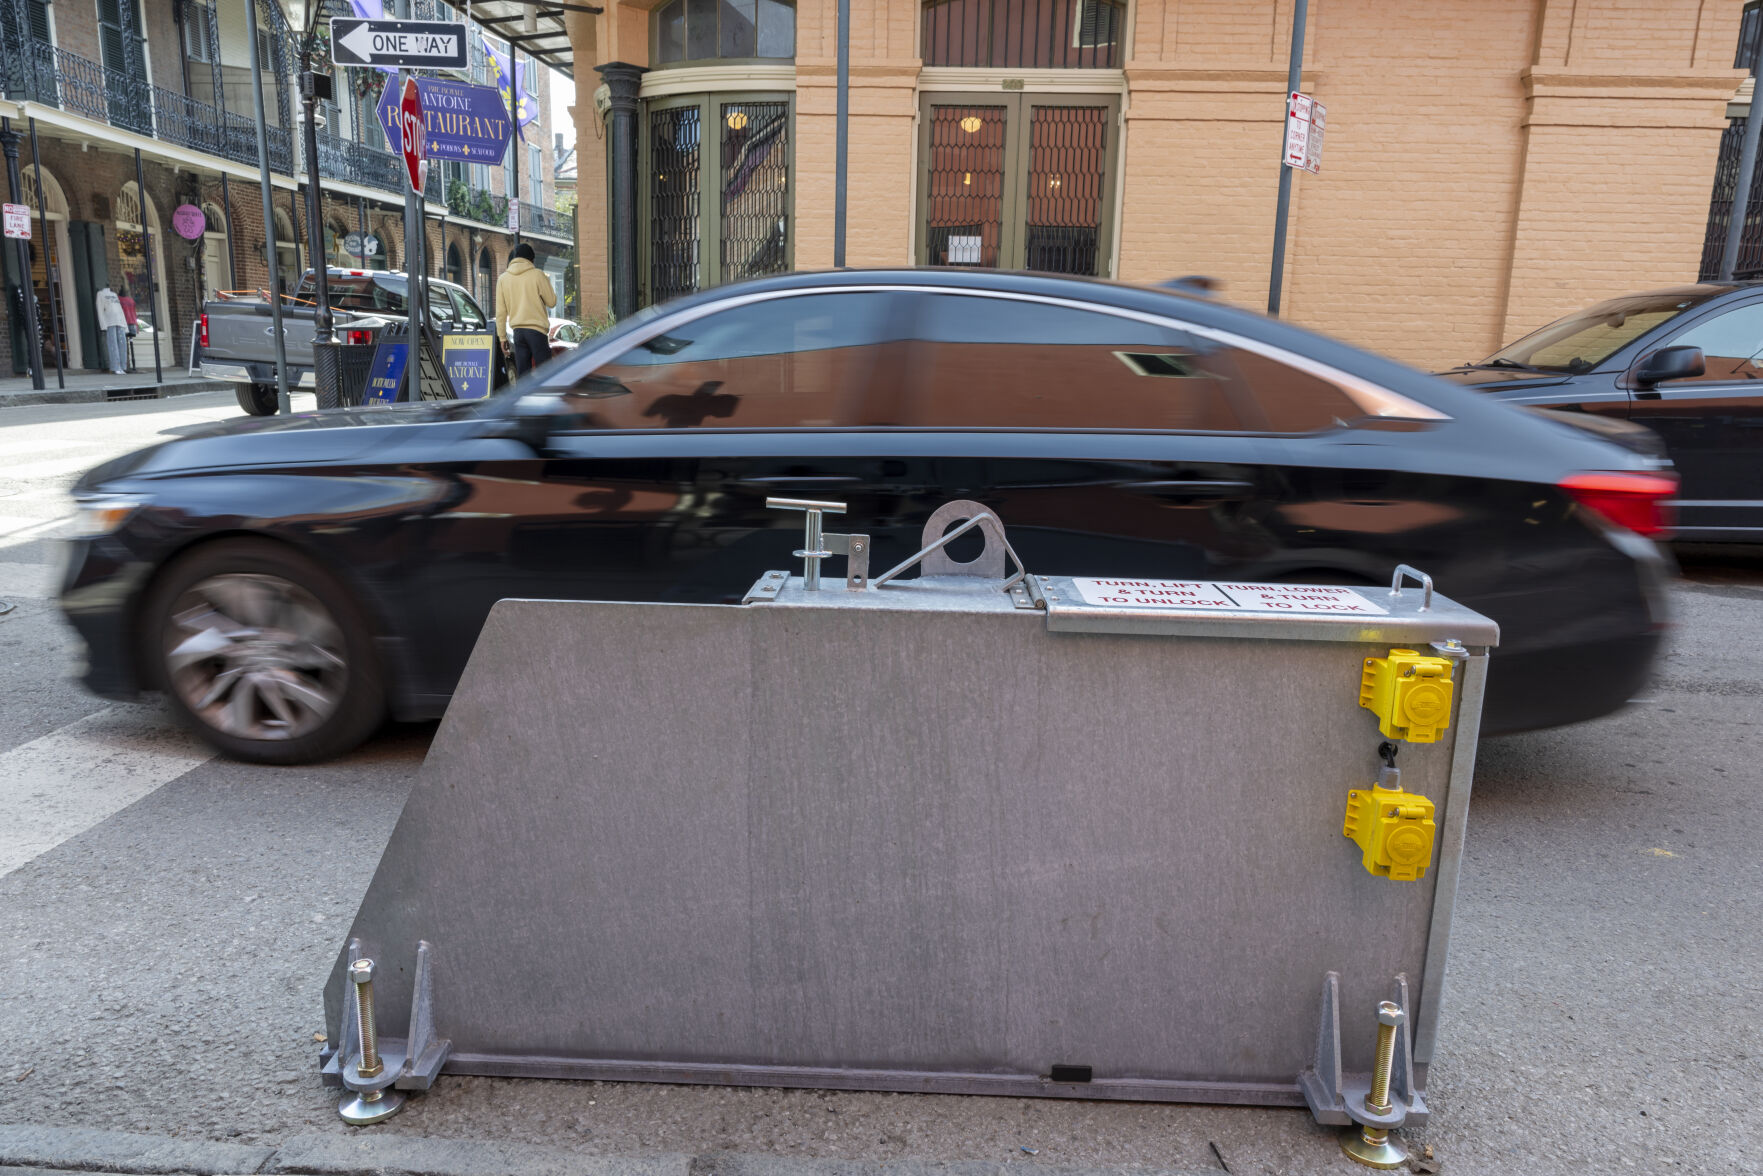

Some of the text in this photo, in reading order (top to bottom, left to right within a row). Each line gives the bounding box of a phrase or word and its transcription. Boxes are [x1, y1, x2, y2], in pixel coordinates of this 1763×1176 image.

[373, 34, 452, 54] ONE WAY
[422, 92, 471, 111] ANTOINE
[387, 104, 505, 141] RTAURANT
[404, 110, 426, 160] STOP
[467, 337, 485, 345] OPEN
[449, 366, 486, 378] ANTOINE
[1134, 589, 1196, 597] TURN
[1282, 586, 1350, 594] LOWER
[1135, 598, 1231, 606] UNLOCK
[1277, 594, 1340, 602] TURN
[1300, 603, 1366, 611] LOCK
